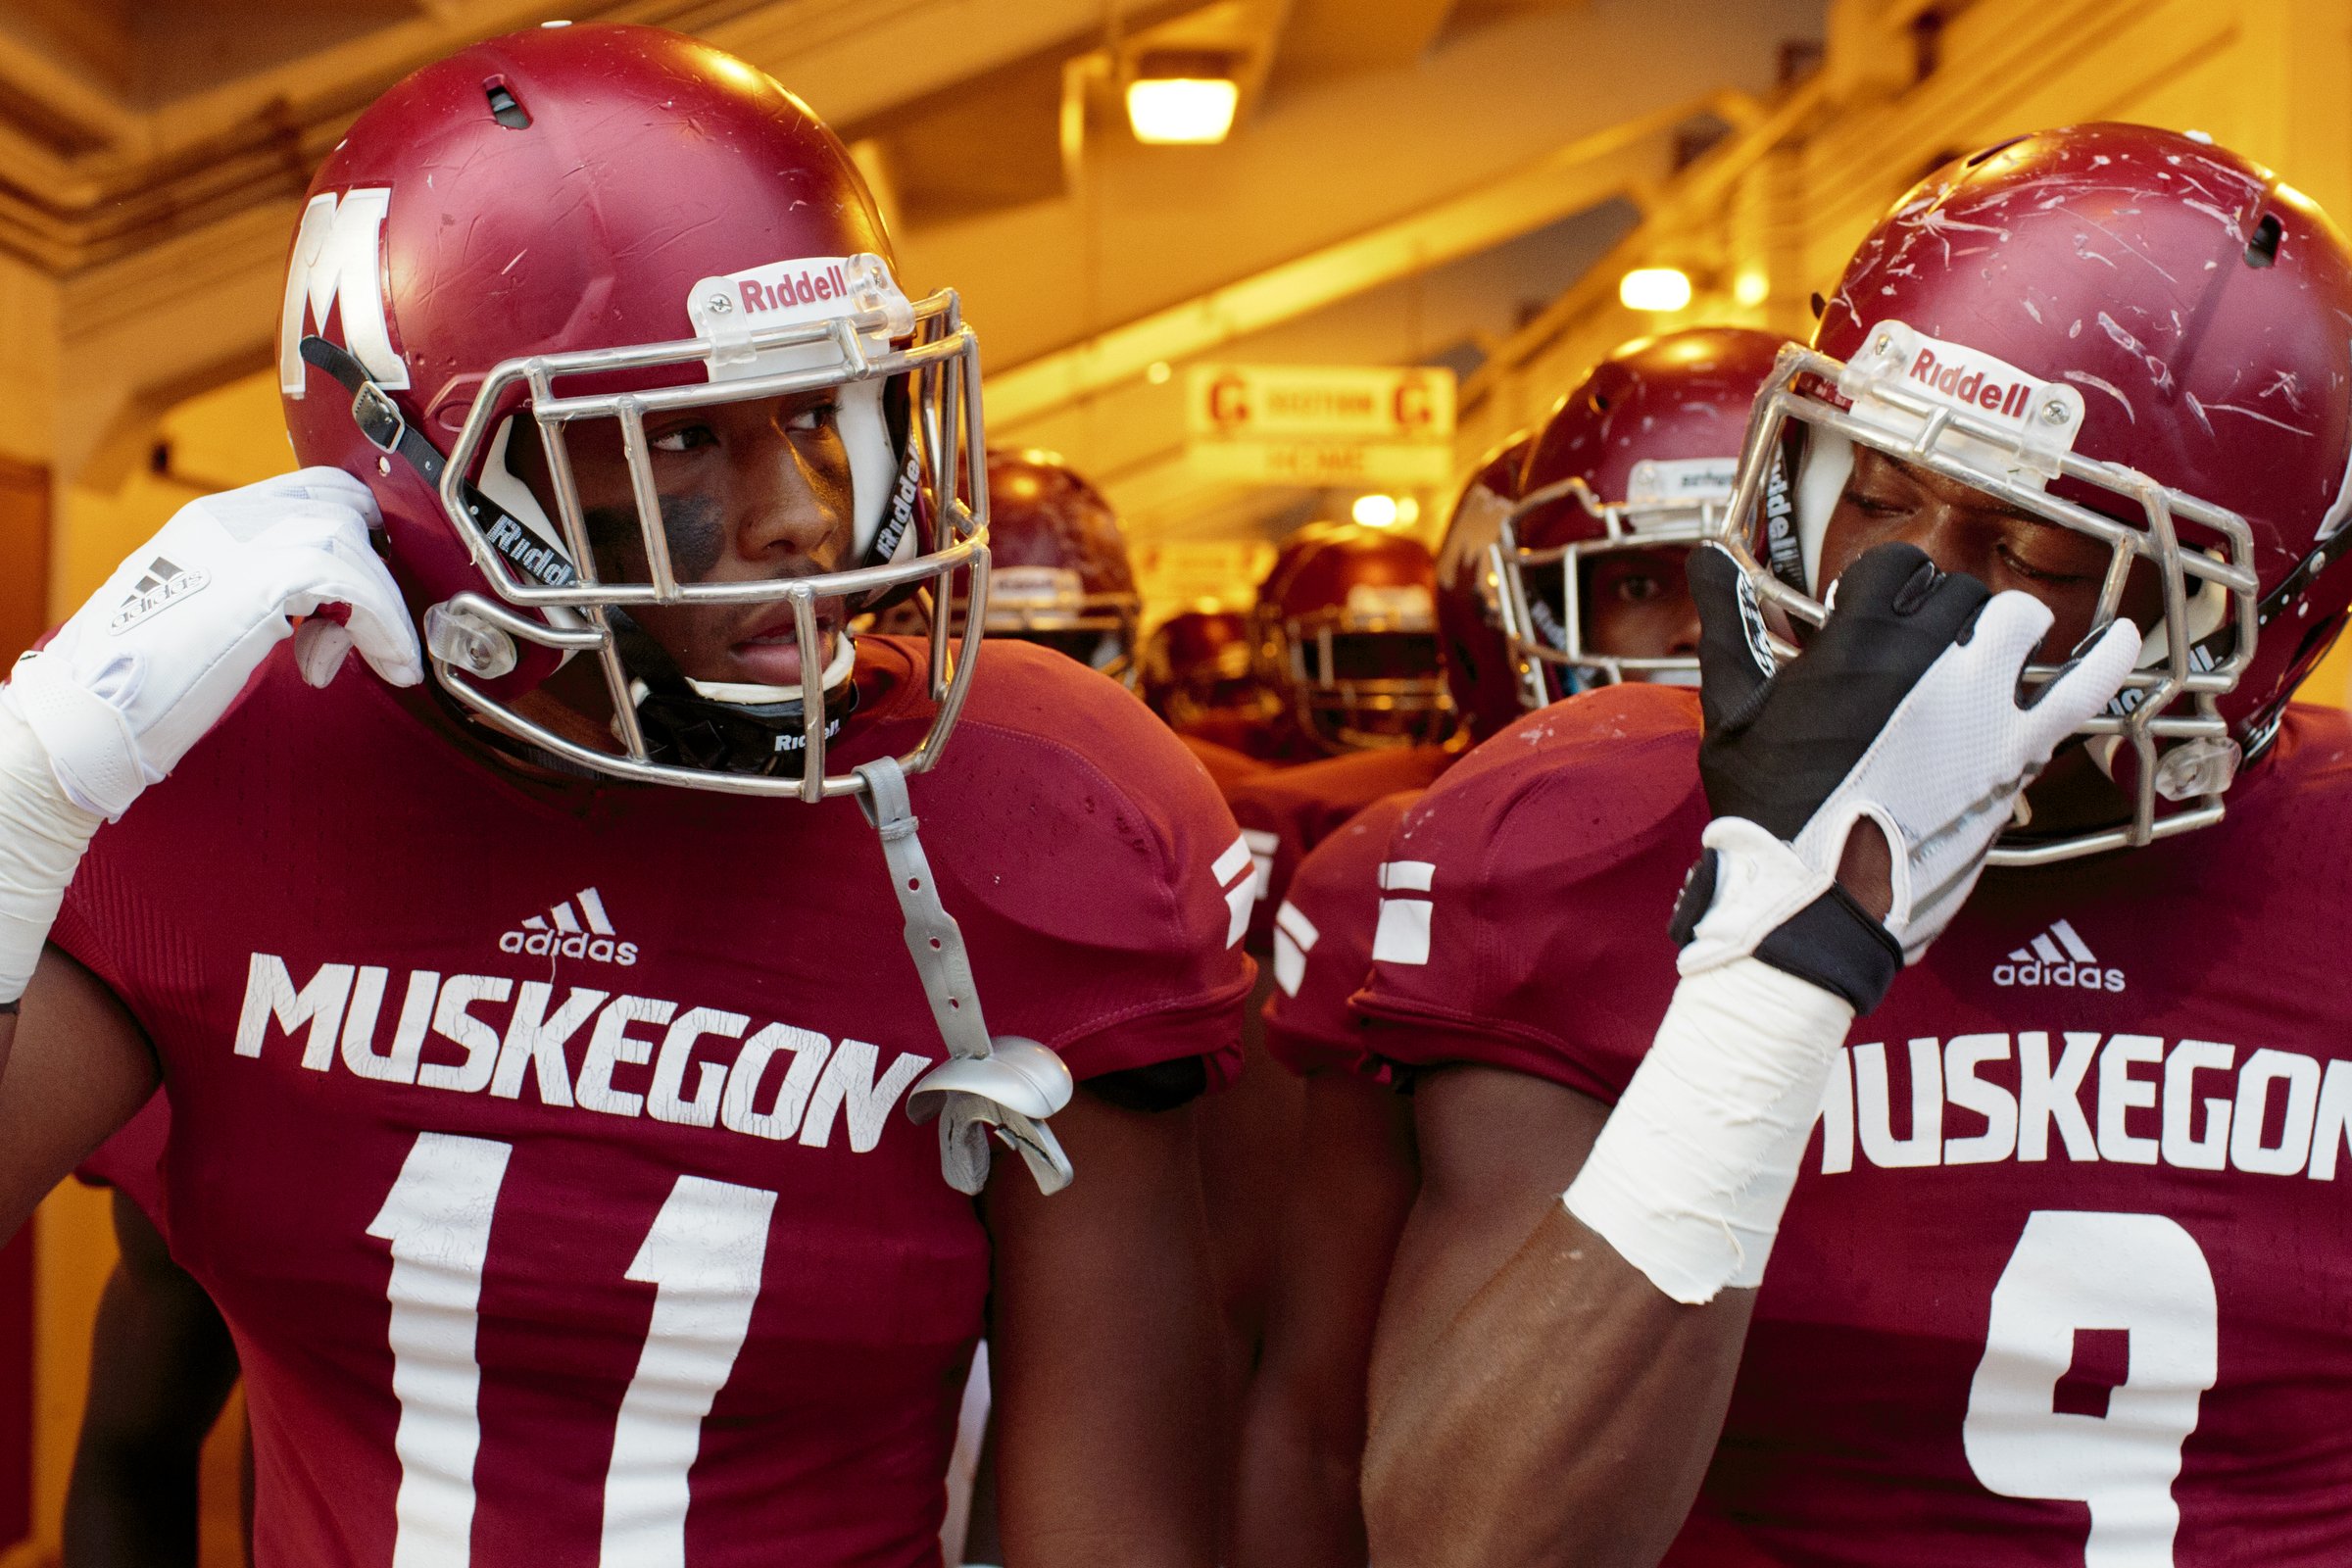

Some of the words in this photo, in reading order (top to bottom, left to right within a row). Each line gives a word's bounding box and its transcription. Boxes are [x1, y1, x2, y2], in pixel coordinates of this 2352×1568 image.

[281, 188, 411, 400] M
[739, 265, 848, 314] Riddell
[1909, 347, 2032, 418] Riddell
[111, 570, 203, 630] adidas
[499, 928, 639, 966] adidas
[1992, 958, 2126, 992] adidas
[233, 951, 933, 1153] MUSKEGON
[366, 1131, 778, 1568] 11
[1963, 1210, 2218, 1568] 9
